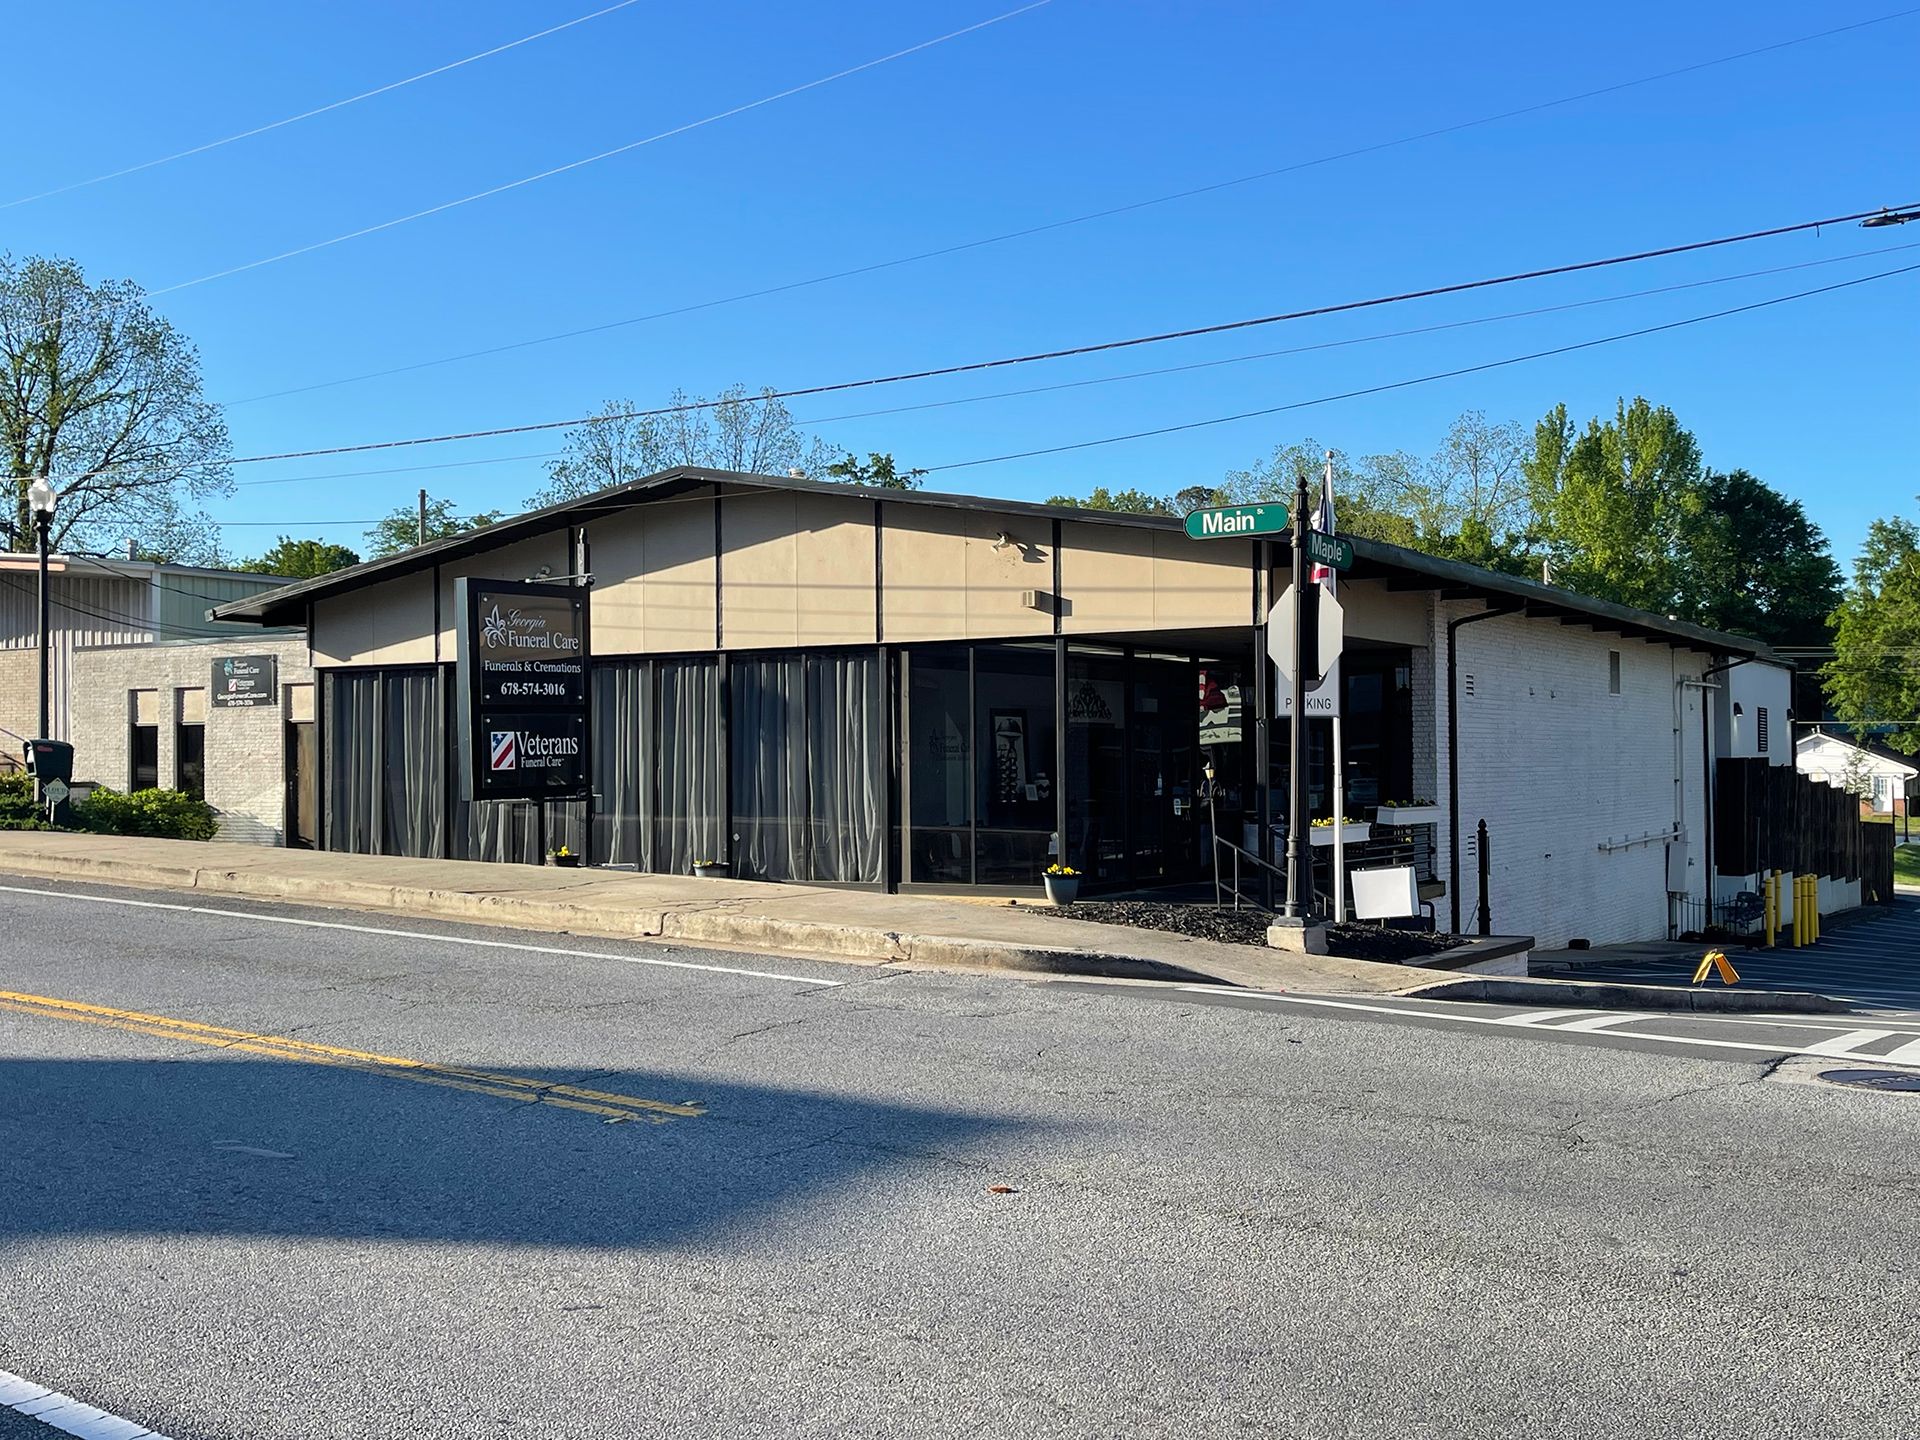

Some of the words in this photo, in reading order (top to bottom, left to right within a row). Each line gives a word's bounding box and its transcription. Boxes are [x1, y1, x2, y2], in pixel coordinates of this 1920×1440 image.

[1203, 512, 1255, 534] Main
[1311, 534, 1343, 563] Maple
[507, 608, 547, 633] Georgia
[508, 630, 550, 649] Funeral
[553, 632, 579, 650] Care
[484, 660, 523, 673] Funerals
[524, 662, 532, 672] &
[533, 661, 581, 674] Cremations
[500, 682, 566, 696] 678-574-3016
[1285, 698, 1332, 710] PKING
[516, 731, 579, 756] Veterans
[521, 756, 546, 768] Funeral
[546, 756, 562, 768] Care
